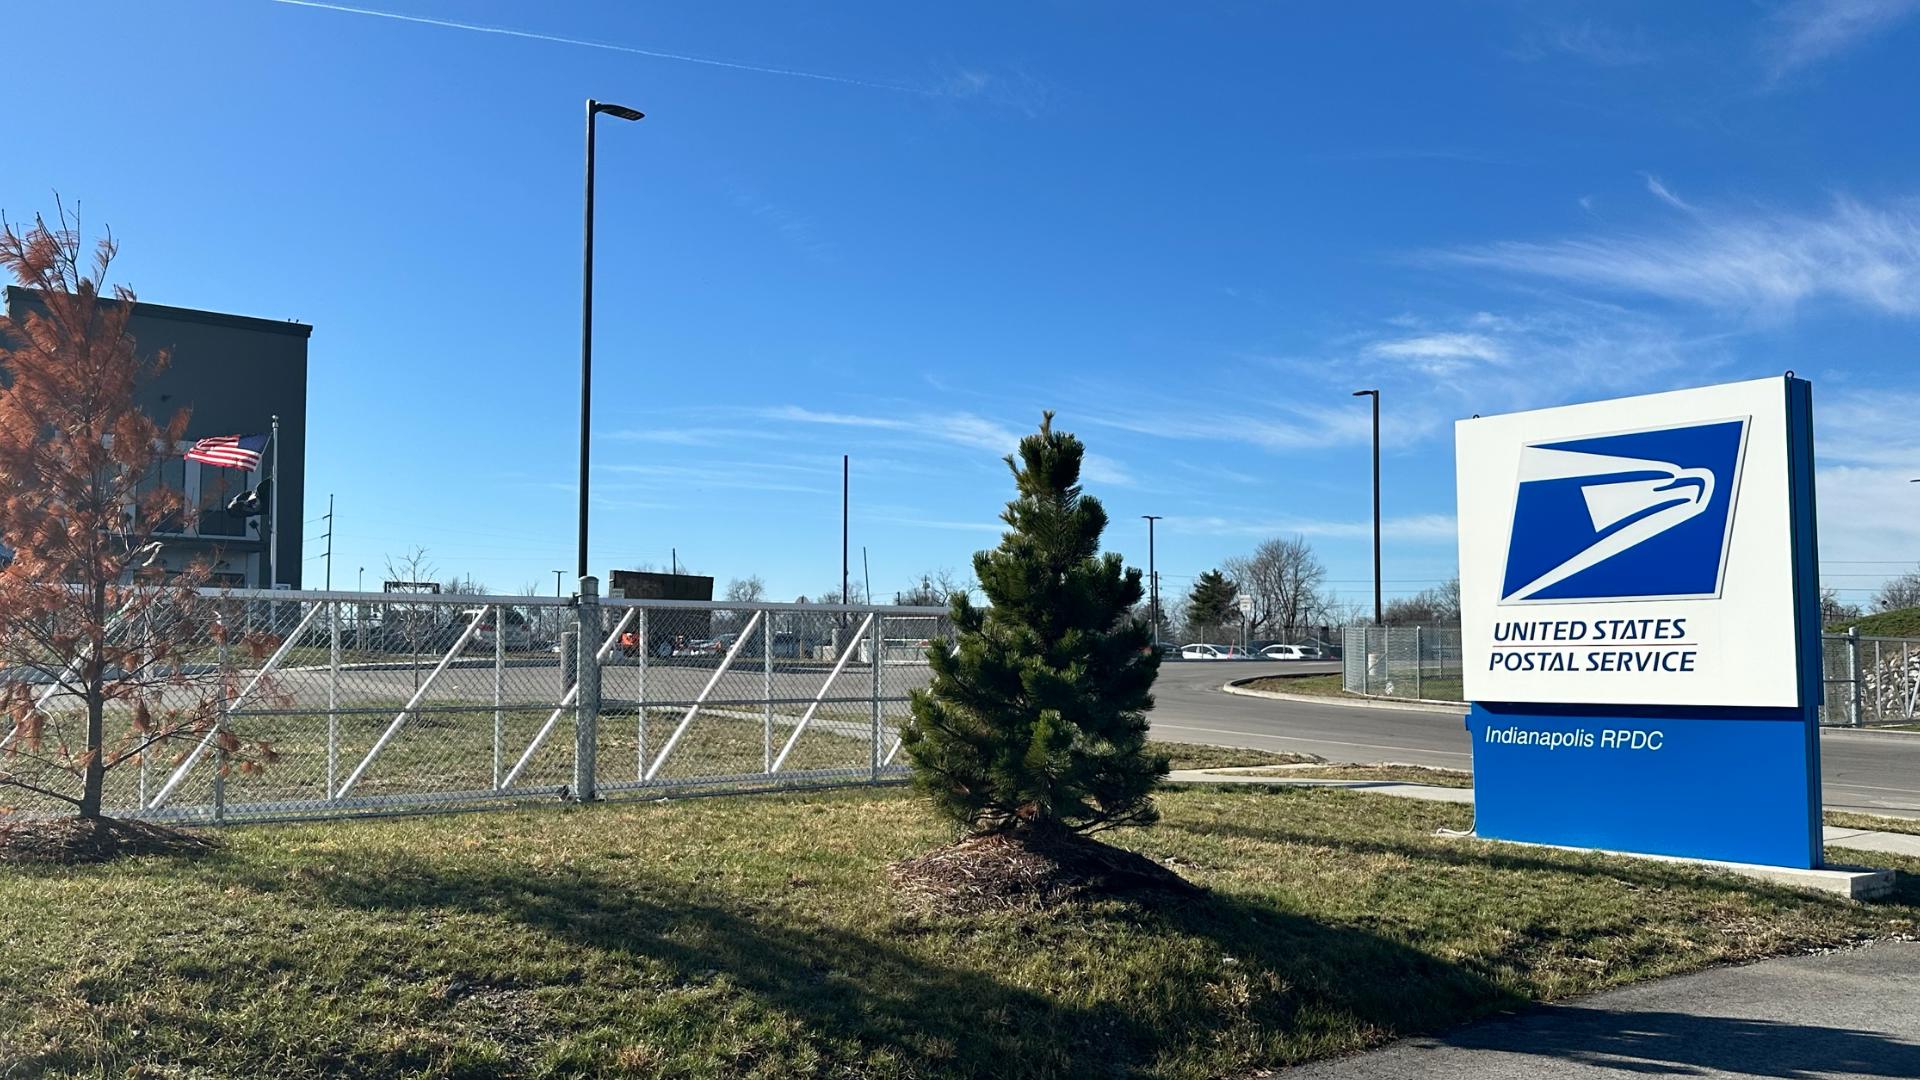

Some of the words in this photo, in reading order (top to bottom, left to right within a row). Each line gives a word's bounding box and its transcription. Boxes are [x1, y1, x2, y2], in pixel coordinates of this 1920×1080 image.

[1494, 620, 1587, 641] UNITED
[1592, 618, 1687, 640] STATES
[1489, 652, 1580, 672] POSTAL
[1585, 651, 1697, 672] SERVICE
[1485, 726, 1594, 750] Indianapolis
[1600, 729, 1664, 751] RPDC
